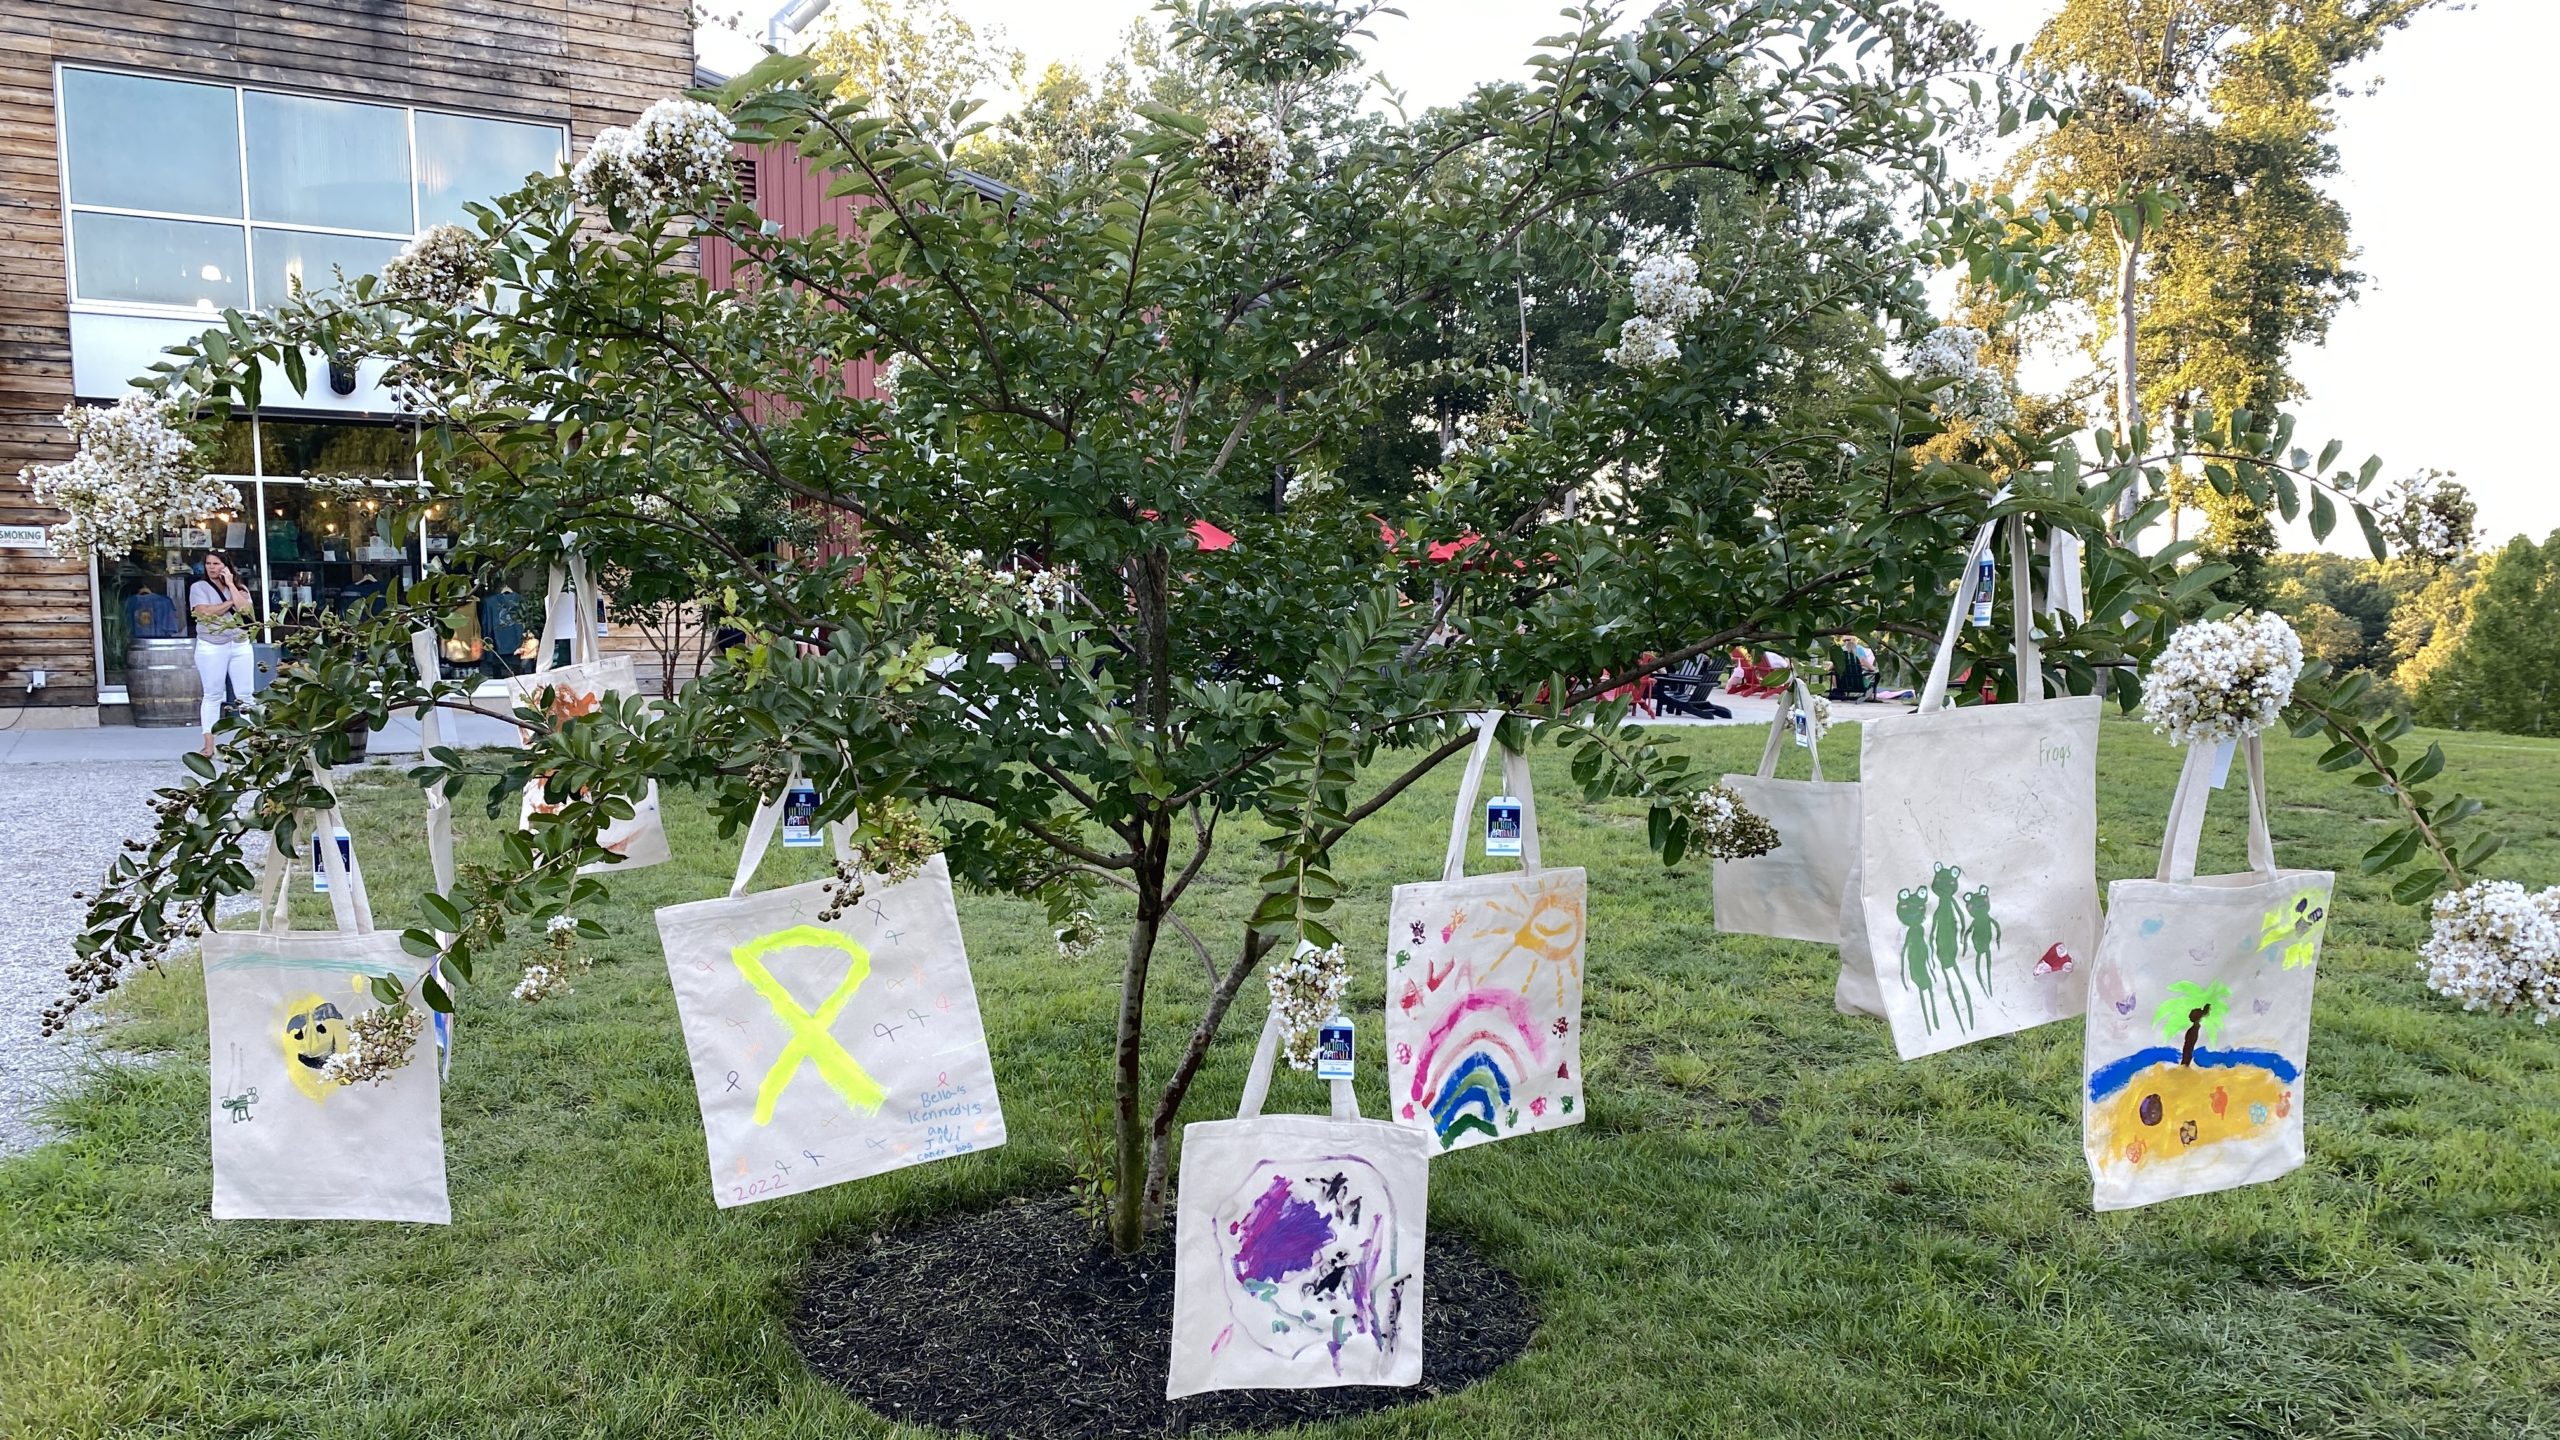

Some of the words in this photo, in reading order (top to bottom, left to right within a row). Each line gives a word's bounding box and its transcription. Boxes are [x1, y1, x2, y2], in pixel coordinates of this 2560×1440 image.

[0, 530, 42, 540] SMOKING
[2039, 736, 2071, 769] Frogs
[920, 1085, 967, 1109] Bella's
[733, 1174, 789, 1201] 2022
